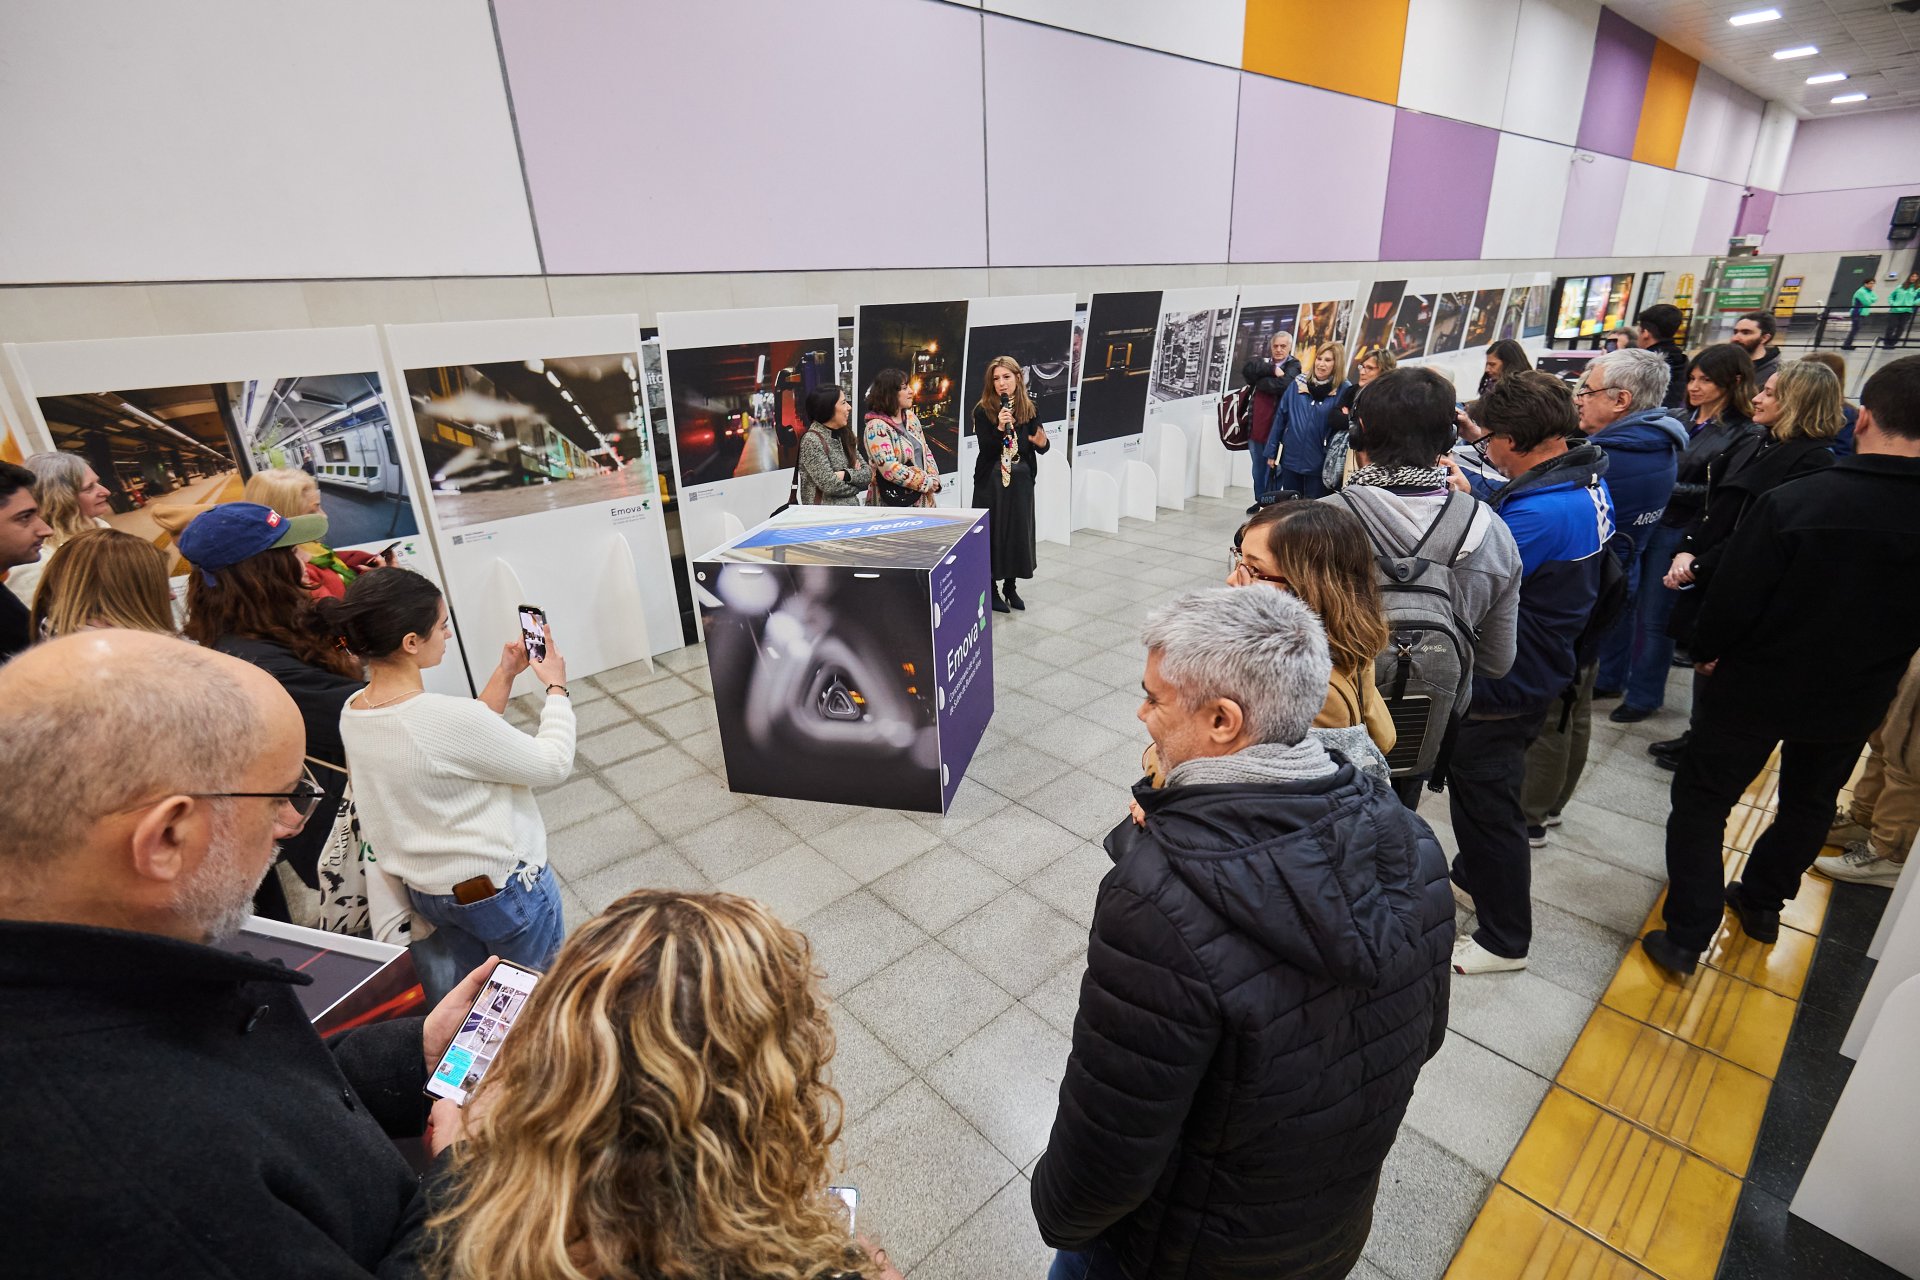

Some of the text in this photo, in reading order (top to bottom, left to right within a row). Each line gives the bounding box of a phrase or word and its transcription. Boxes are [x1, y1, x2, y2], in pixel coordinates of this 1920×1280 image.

[610, 505, 642, 517] Emova
[866, 520, 924, 532] Retiro
[947, 622, 979, 682] Emova
